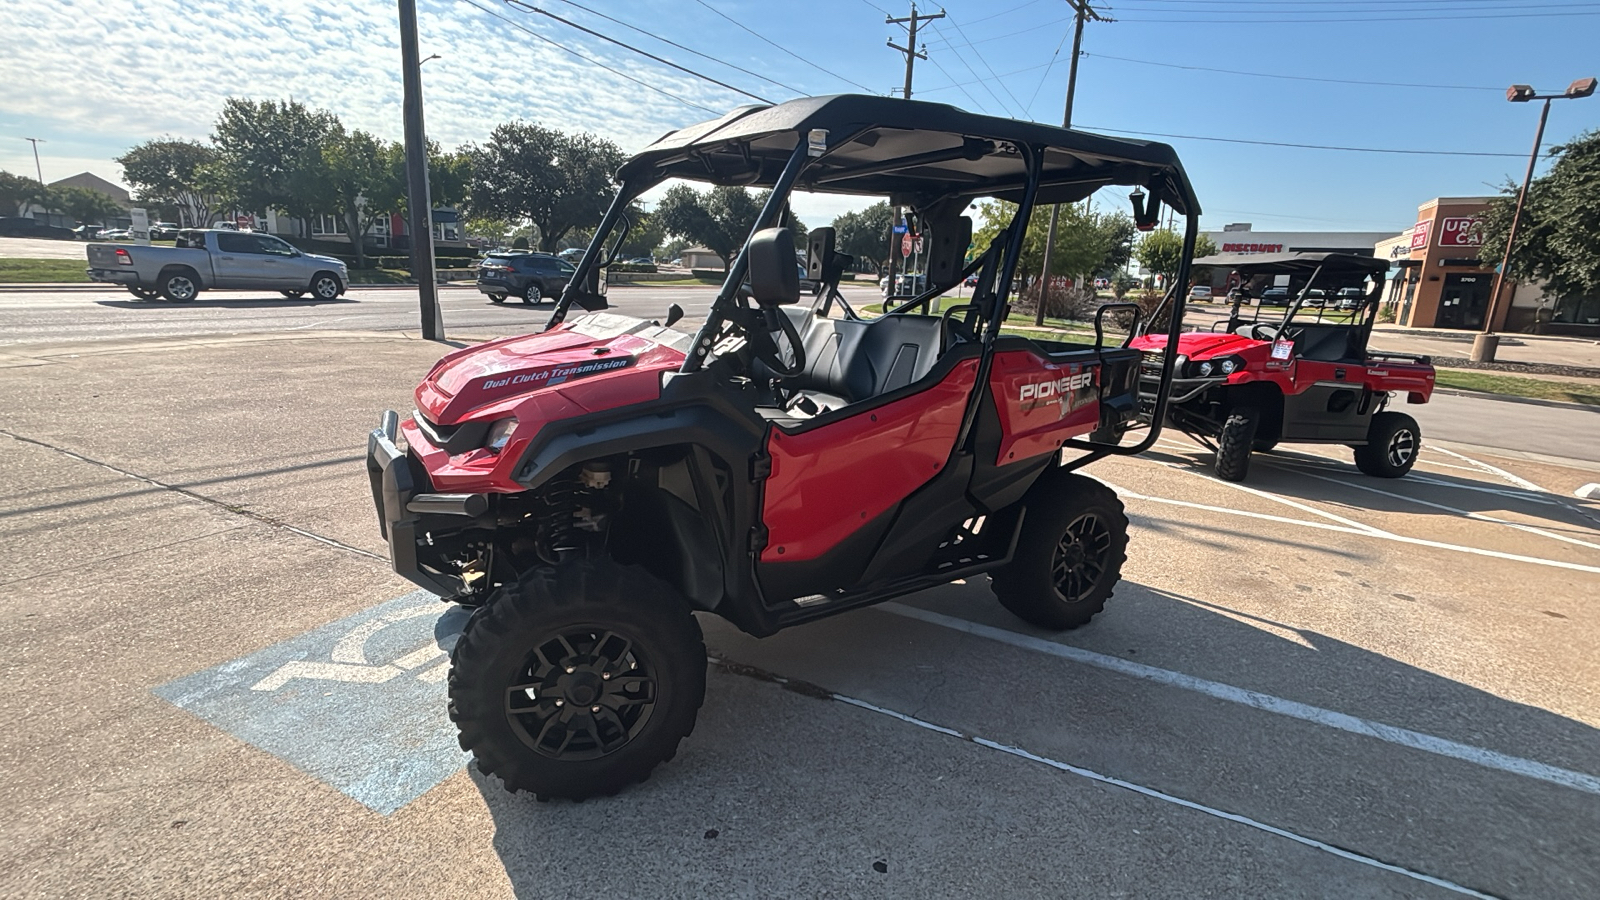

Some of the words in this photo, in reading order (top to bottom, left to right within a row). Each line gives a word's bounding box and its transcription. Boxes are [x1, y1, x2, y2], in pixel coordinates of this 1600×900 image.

[1222, 243, 1283, 253] DISCOUNT
[483, 379, 510, 390] Dual
[512, 371, 549, 384] Clutch
[551, 360, 627, 377] Transmission
[1020, 373, 1092, 402] PIONEER
